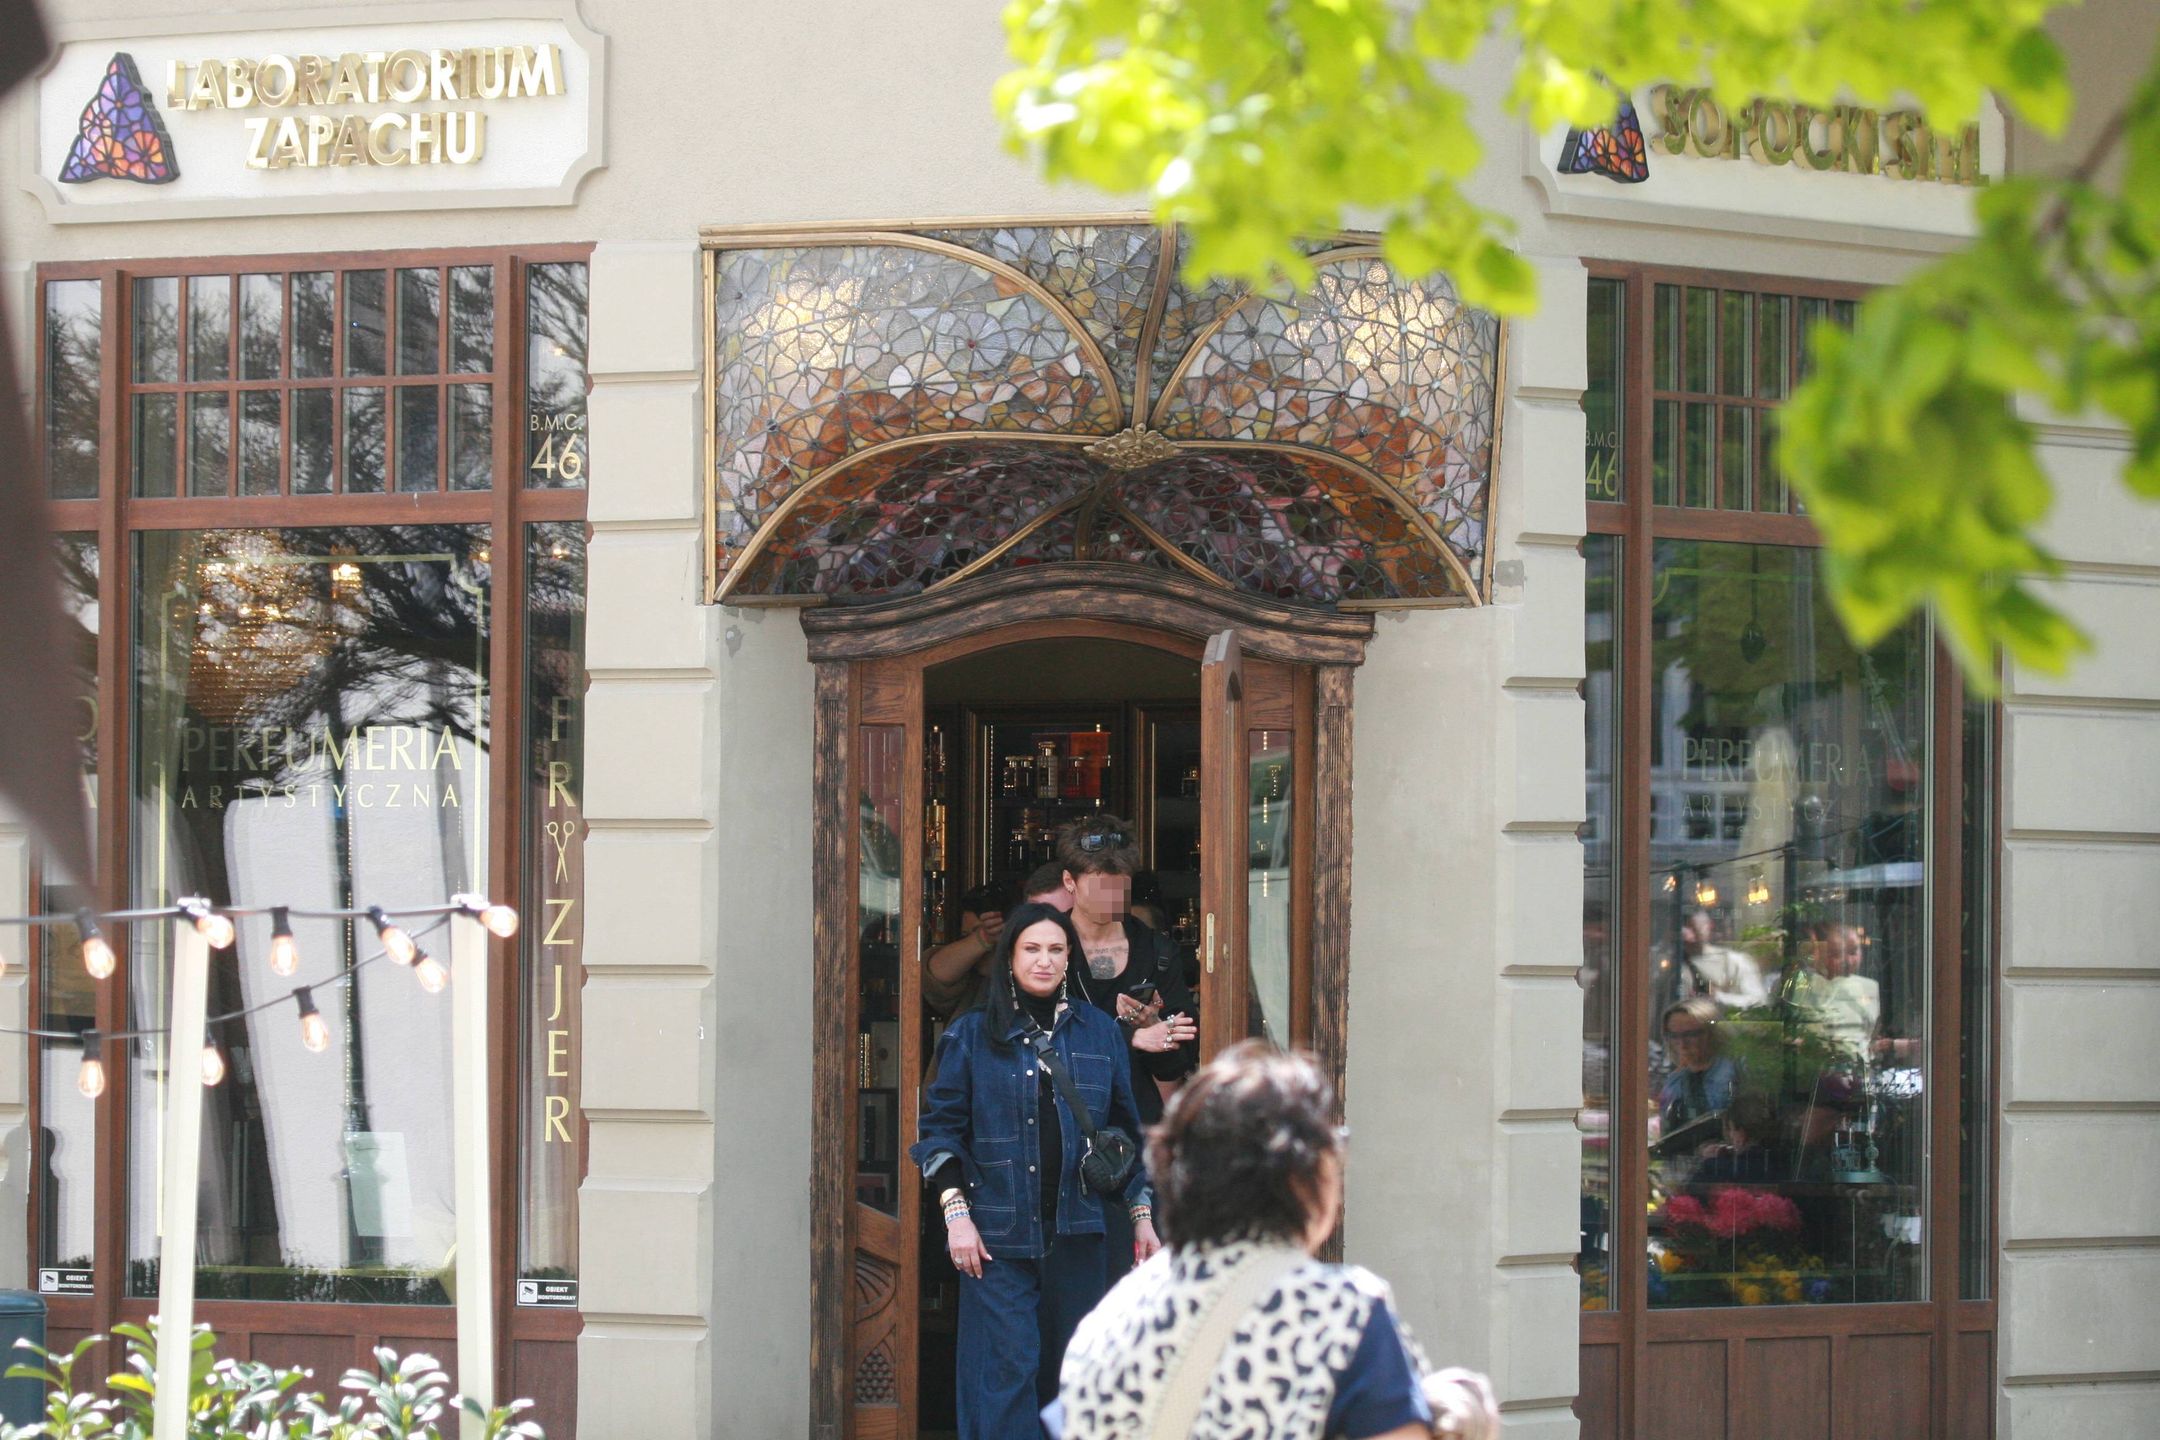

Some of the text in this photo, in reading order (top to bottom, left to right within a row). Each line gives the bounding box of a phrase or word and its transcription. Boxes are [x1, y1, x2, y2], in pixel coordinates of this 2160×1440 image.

[166, 43, 565, 111] LABORATORIUM
[244, 111, 488, 170] ZAPACHU
[530, 413, 582, 431] B.M.C.
[530, 432, 581, 480] 46
[1585, 449, 1617, 497] 46
[180, 724, 463, 772] PERFUMERIA
[180, 784, 461, 809] ARTYSTYCZNA
